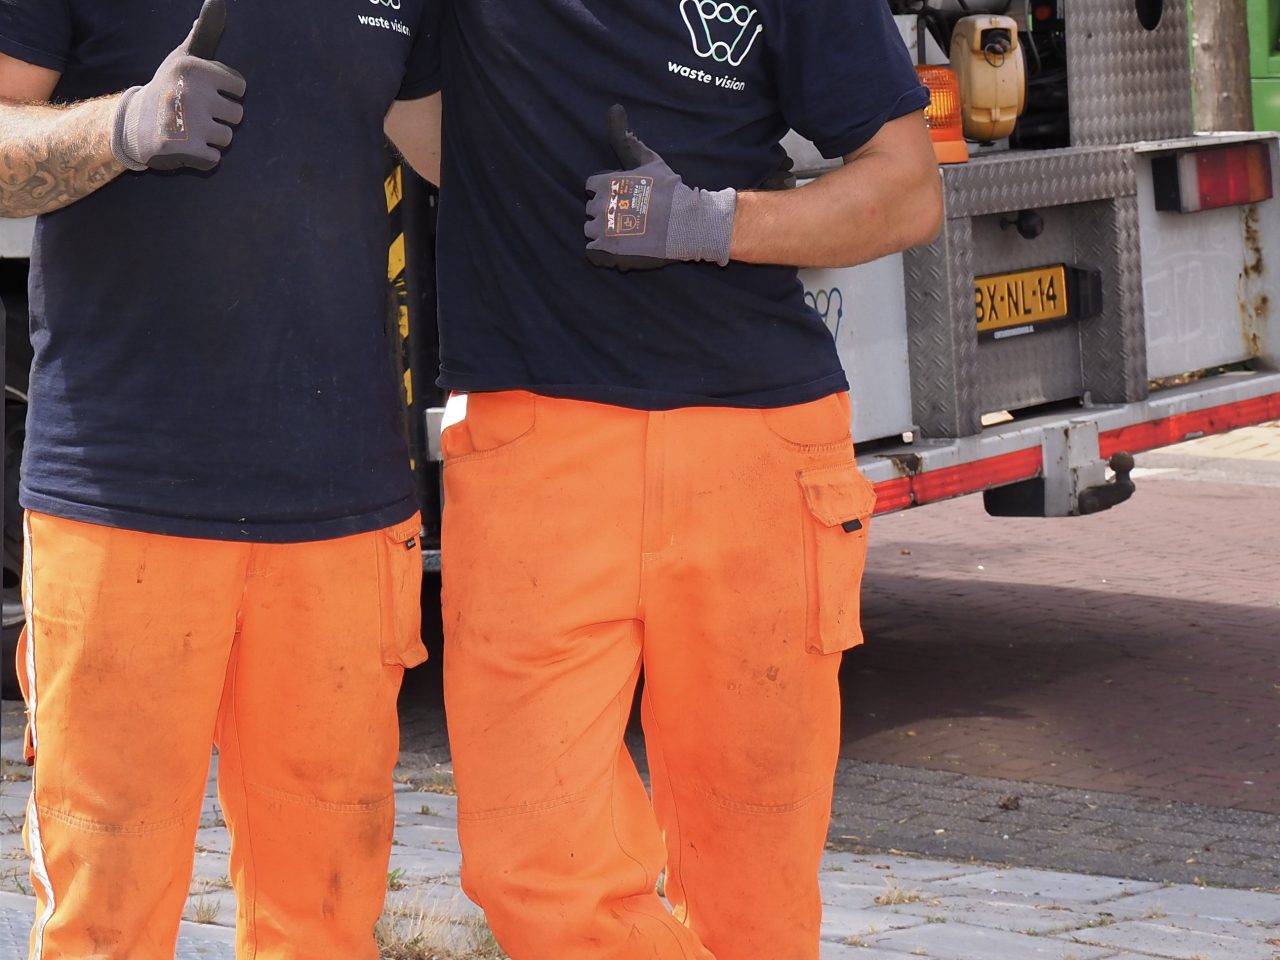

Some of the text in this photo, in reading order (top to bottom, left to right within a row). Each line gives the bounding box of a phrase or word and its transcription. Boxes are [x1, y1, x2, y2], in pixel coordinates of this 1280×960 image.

[358, 14, 411, 36] waste vision
[668, 61, 745, 91] waste vision
[607, 180, 620, 230] MXT
